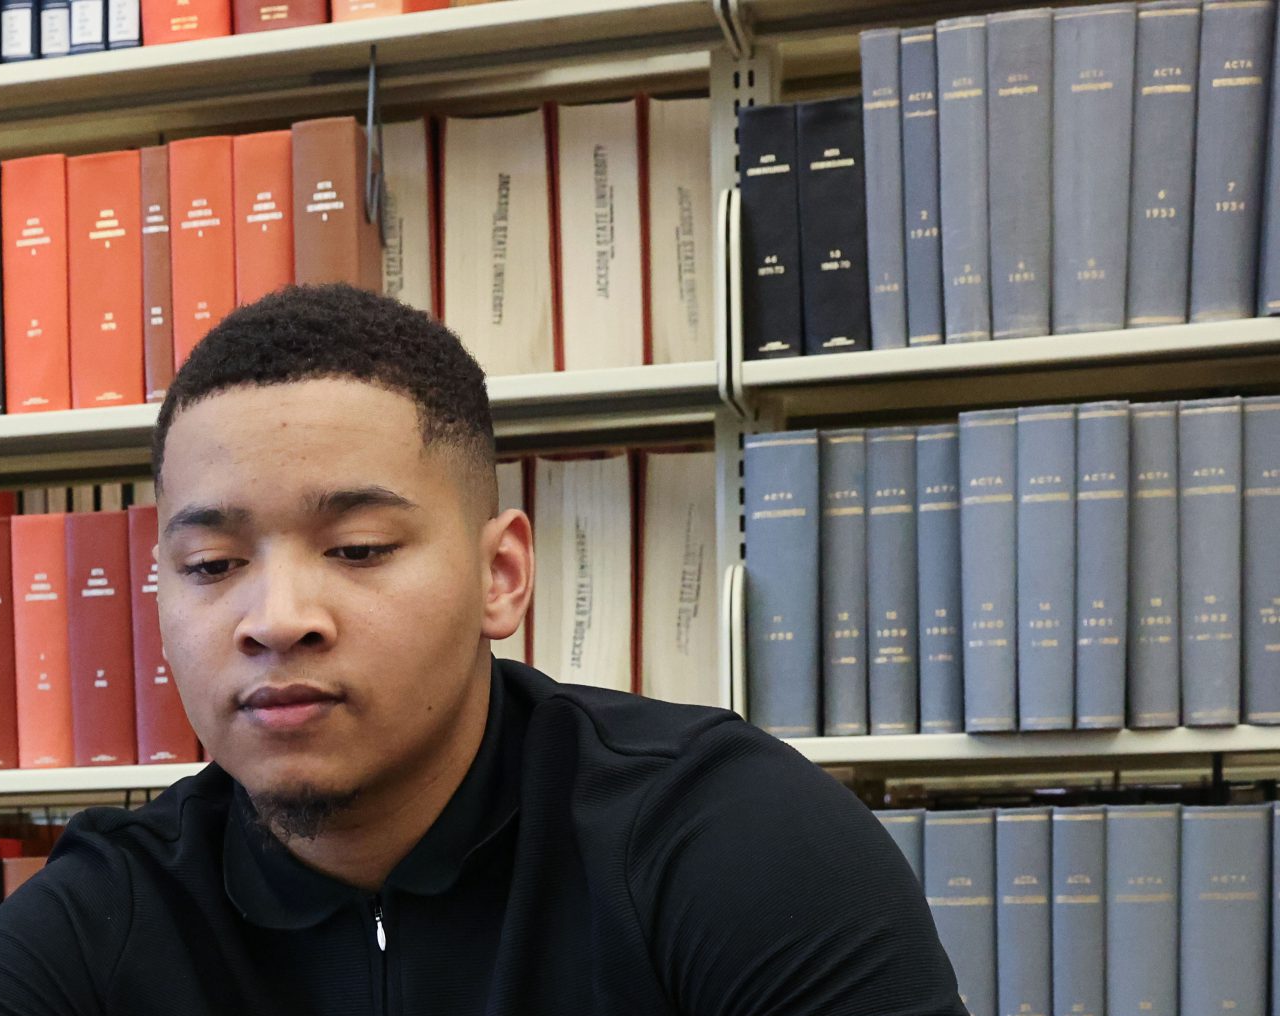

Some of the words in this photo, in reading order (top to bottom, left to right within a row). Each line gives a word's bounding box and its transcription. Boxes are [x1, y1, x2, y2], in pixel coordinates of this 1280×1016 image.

[1224, 60, 1253, 70] ACTA
[1153, 67, 1182, 77] ACTA
[907, 91, 934, 101] ACTA
[593, 144, 608, 208] UNIVERSITY
[1227, 181, 1236, 192] 7
[1158, 190, 1166, 200] 6
[920, 210, 929, 220] 2
[1145, 208, 1176, 219] 1953
[595, 213, 608, 246] STATE
[910, 227, 938, 239] 1949
[493, 227, 509, 259] STATE
[597, 250, 609, 298] JACKSON
[1083, 473, 1116, 482] ACTA
[1193, 468, 1225, 477] ACTA
[970, 476, 1003, 487] ACTA
[1029, 476, 1062, 485] ACTA
[876, 488, 906, 498] ACTA
[576, 584, 588, 616] STATE
[948, 877, 972, 887] ACTA
[1014, 875, 1038, 885] ACTA
[1067, 874, 1091, 884] ACTA
